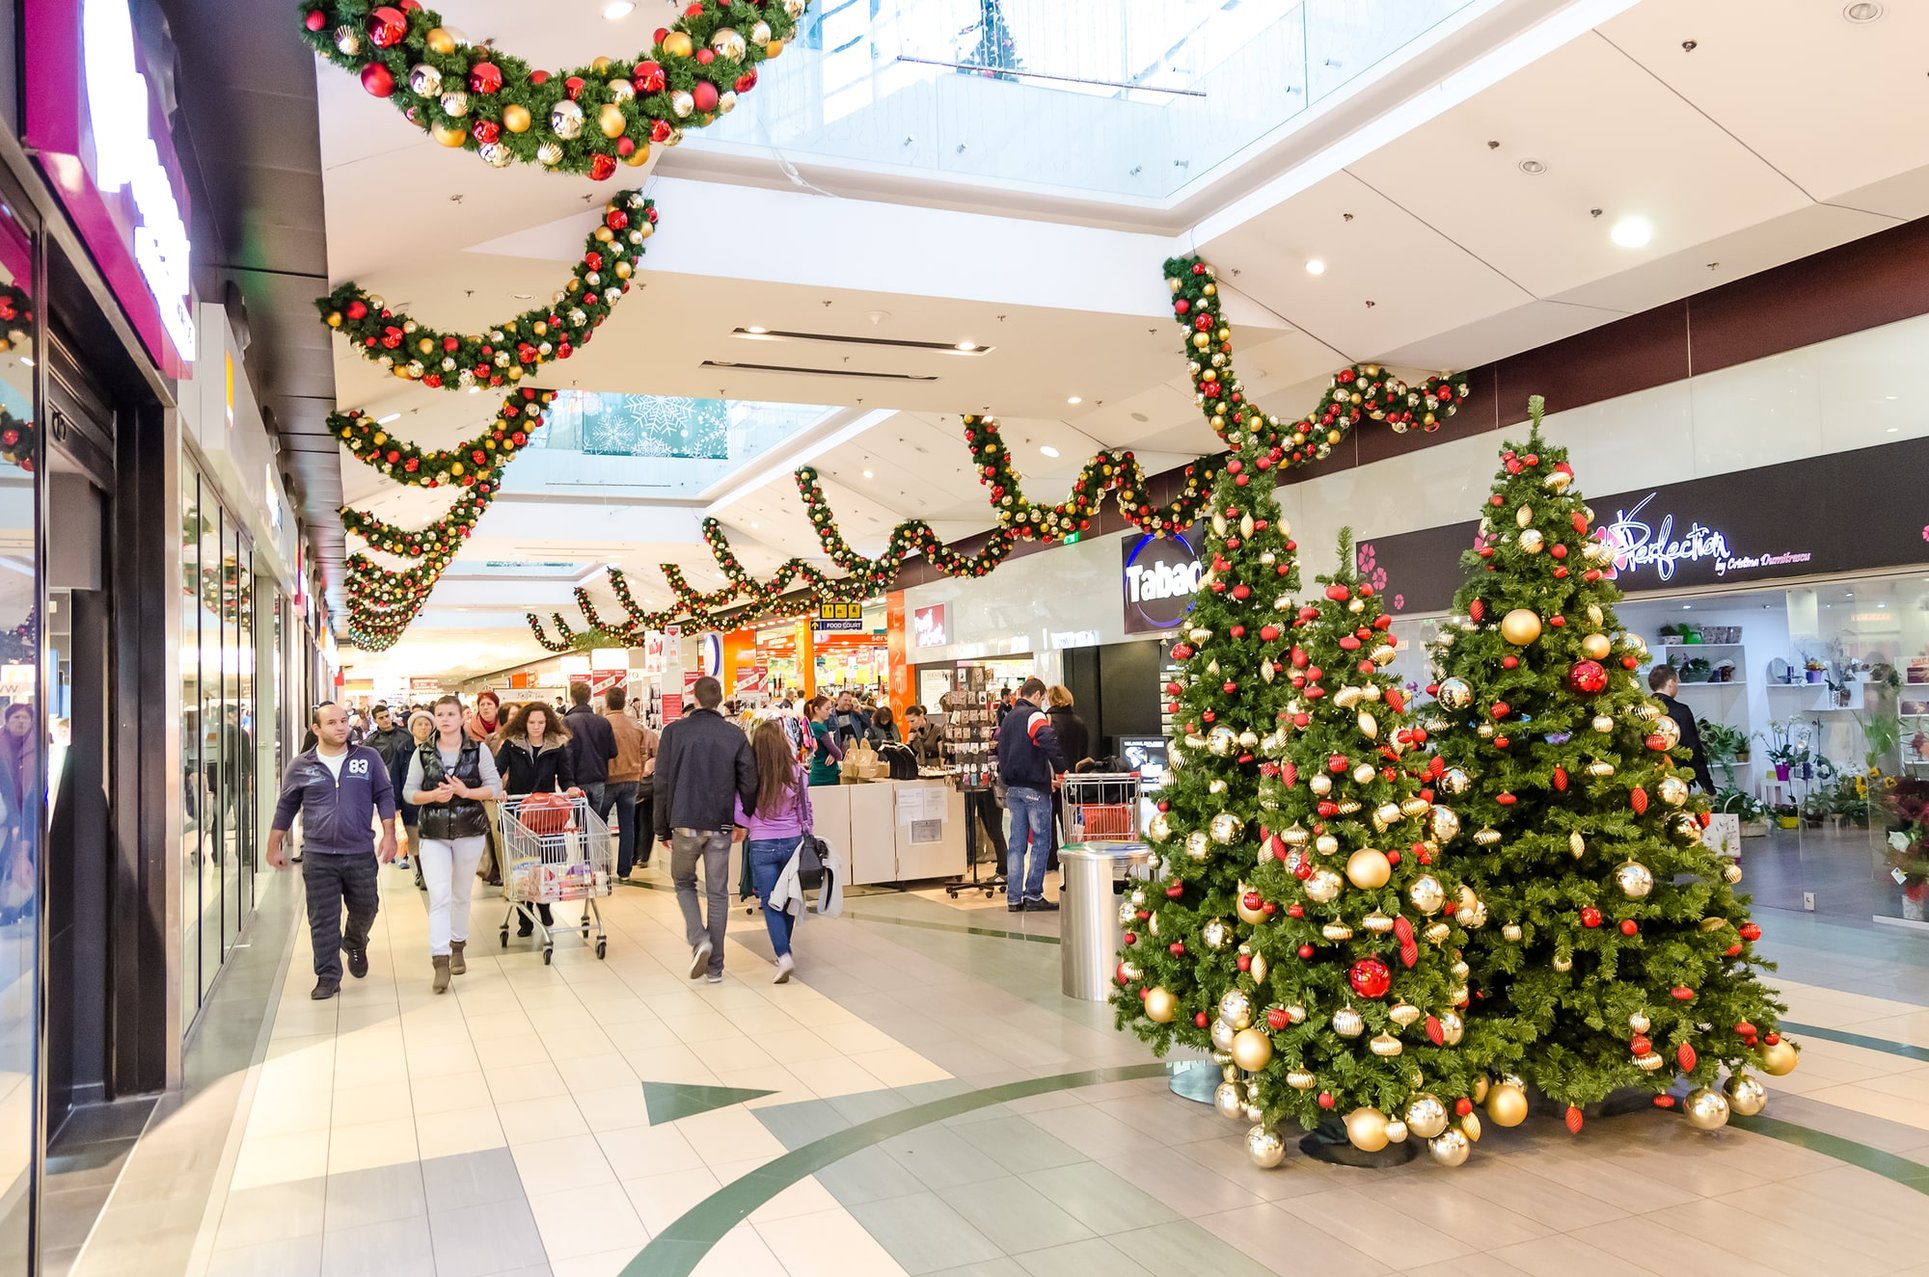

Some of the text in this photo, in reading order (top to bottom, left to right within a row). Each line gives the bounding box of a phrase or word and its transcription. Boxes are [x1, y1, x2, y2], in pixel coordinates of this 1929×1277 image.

[1608, 492, 1731, 581] Perfection
[1714, 557, 1727, 577] by
[1727, 556, 1760, 570] Cristina
[842, 621, 861, 629] COURT
[348, 759, 369, 774] 83
